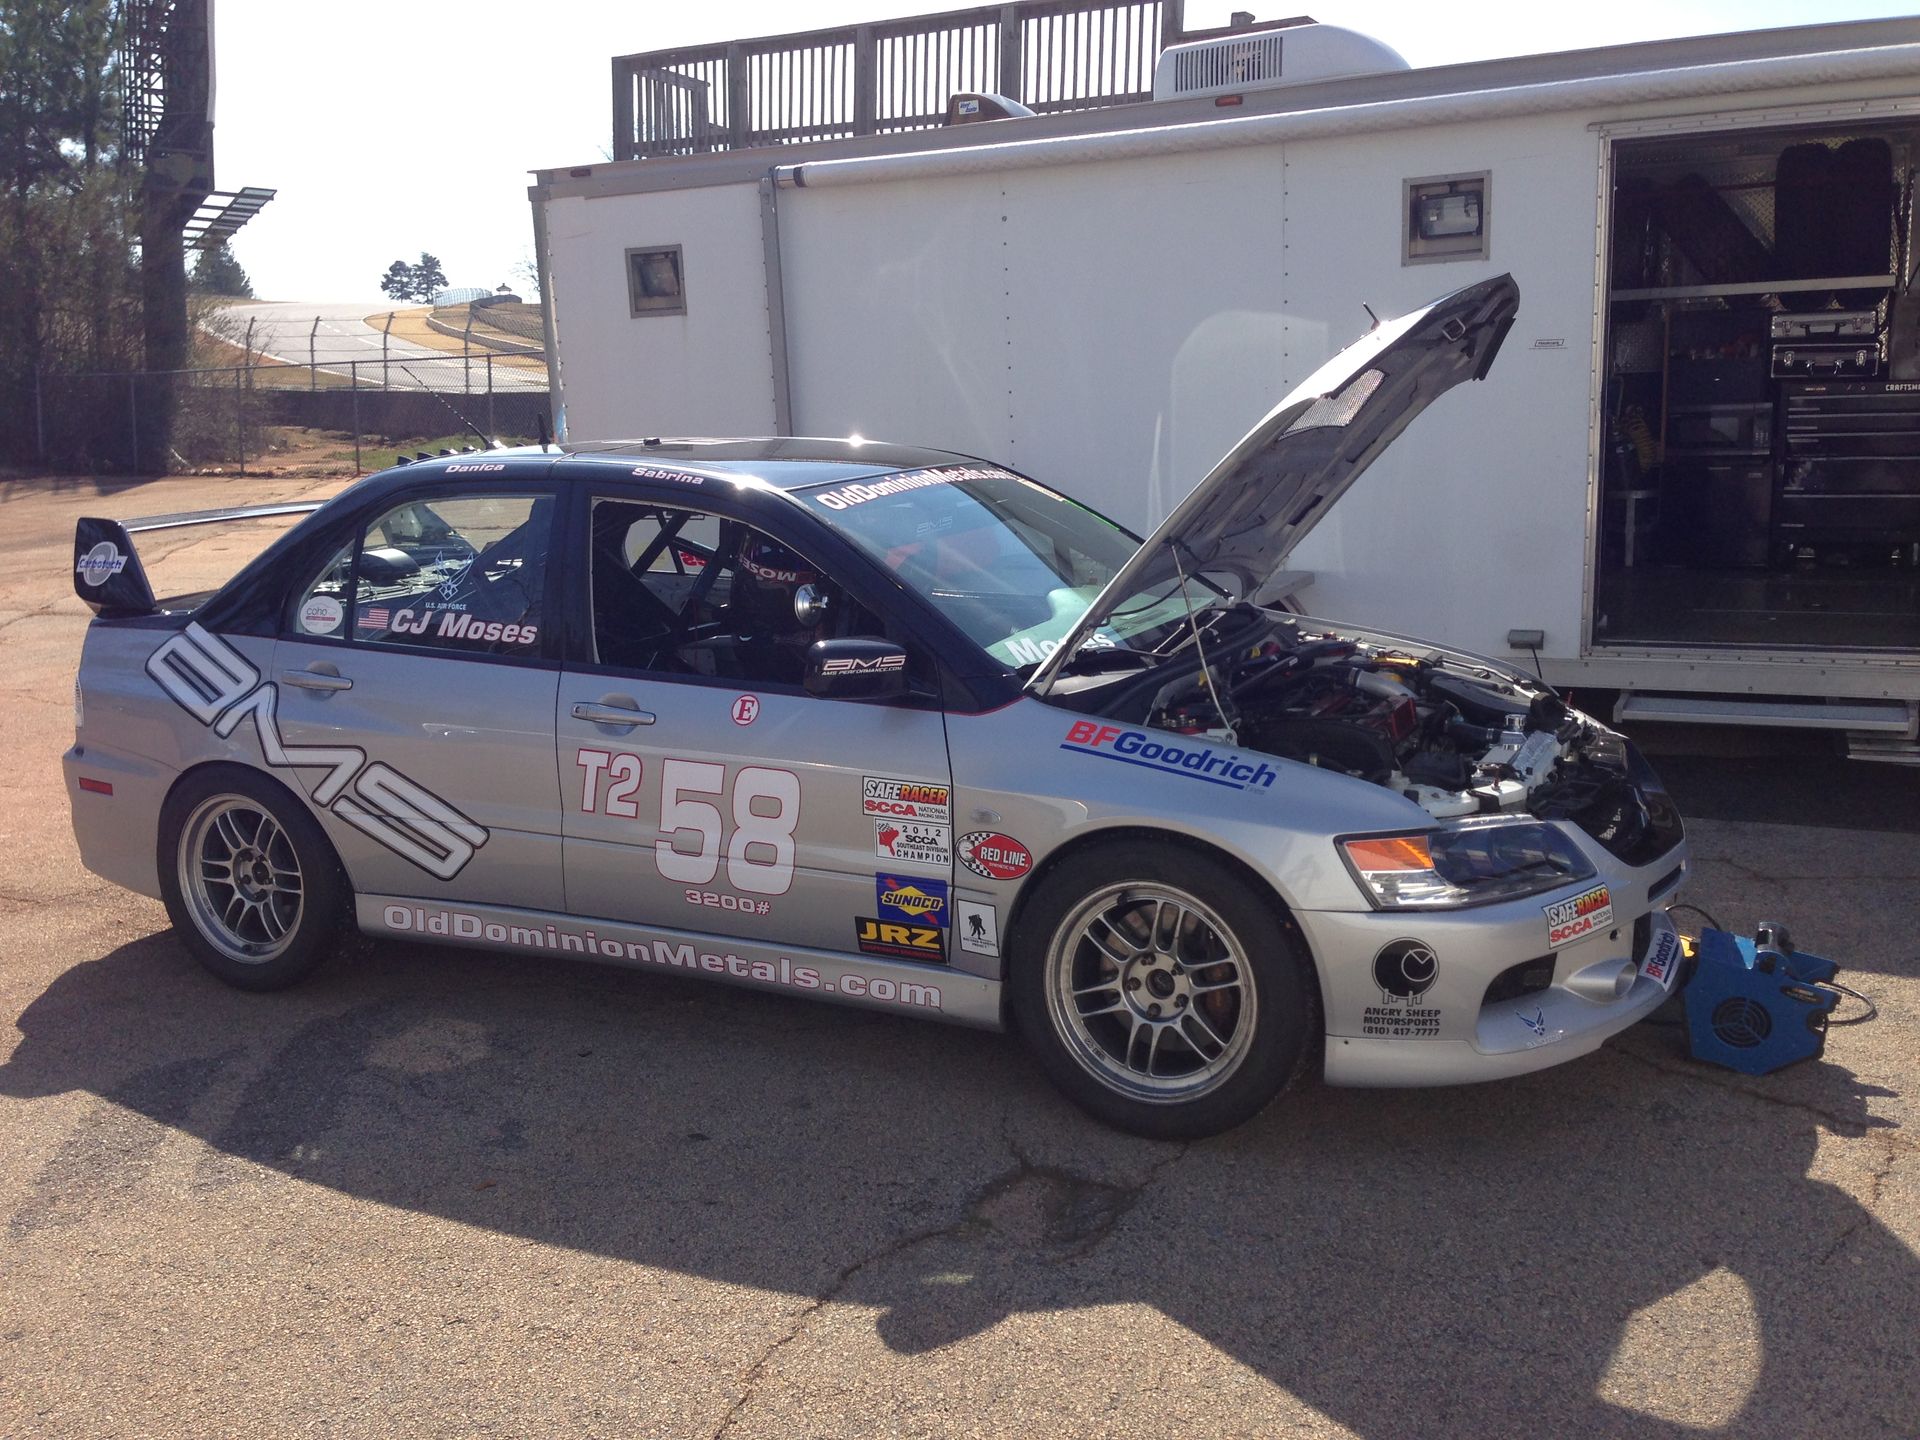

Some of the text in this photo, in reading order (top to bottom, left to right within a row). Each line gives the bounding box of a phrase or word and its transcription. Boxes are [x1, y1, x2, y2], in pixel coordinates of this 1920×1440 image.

[445, 463, 505, 473] Danica
[632, 467, 704, 485] Sabrina
[391, 609, 538, 644] CJ Moses
[735, 698, 755, 722] E
[1065, 720, 1277, 788] BFGoodrich
[576, 748, 643, 819] T2
[865, 780, 949, 806] SAFERACER
[865, 800, 918, 816] SCCA
[918, 806, 948, 815] NATIONAL
[655, 758, 801, 895] 58
[896, 842, 949, 854] SOUTHEAST DIVISION
[905, 834, 938, 846] SCCA
[896, 849, 949, 863] CHAMPION
[980, 846, 1026, 867] RED LINE
[685, 889, 770, 915] 3200#
[883, 892, 942, 911] SUNOCO
[860, 922, 940, 949] JRZ
[1551, 917, 1593, 943] SCCA
[383, 904, 943, 1009] OldDominionMetals.com
[1645, 931, 1677, 980] BFGoodrich
[1363, 1016, 1440, 1026] MOTORSPORTS
[1365, 1007, 1441, 1018] ANGRY SHEEP
[1363, 1025, 1440, 1036] (810) 417-7777
